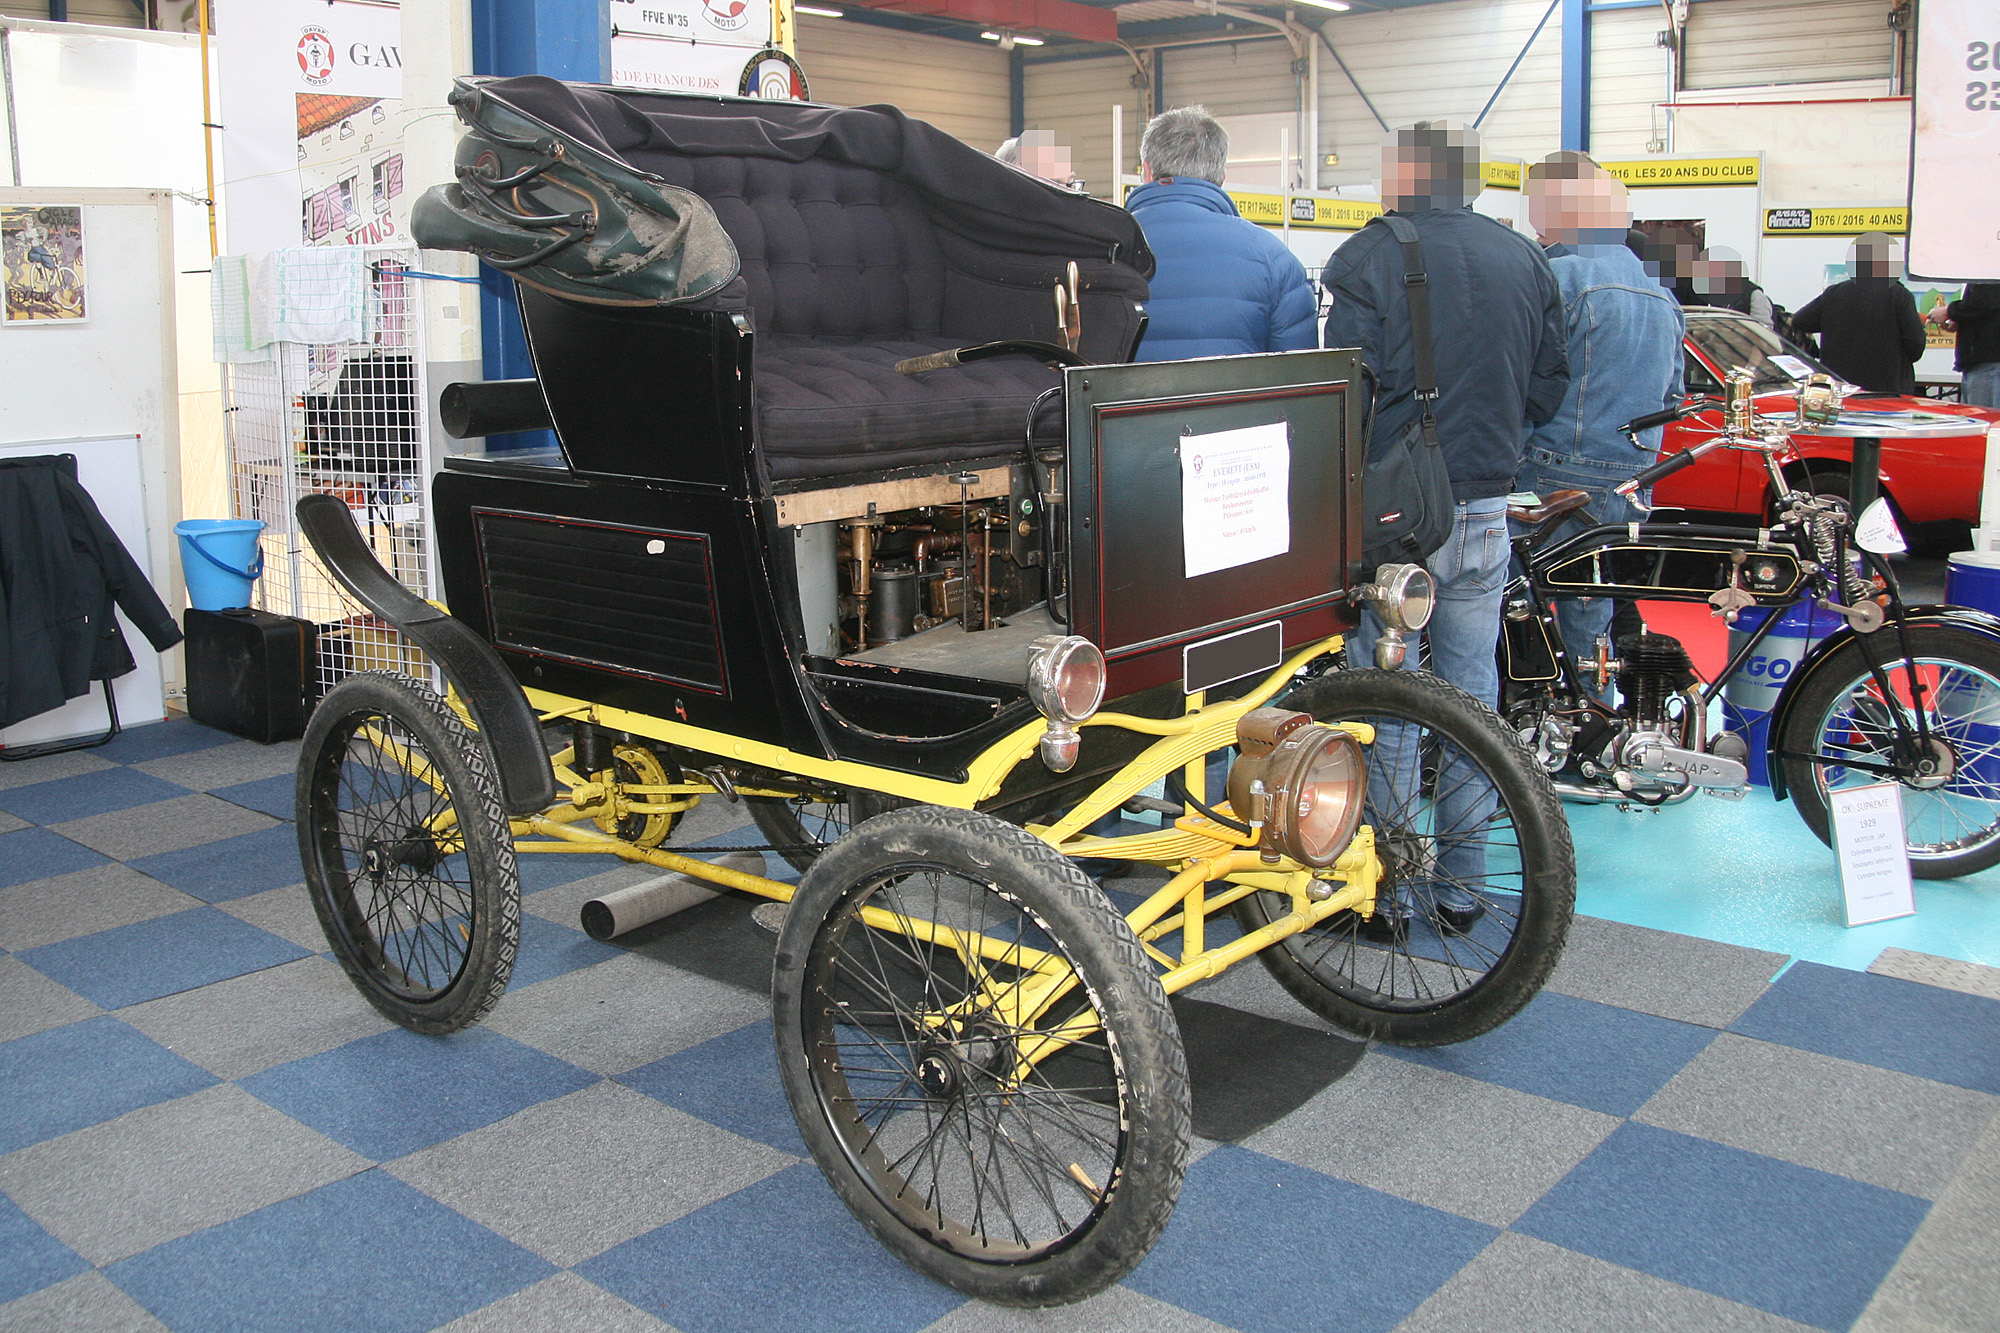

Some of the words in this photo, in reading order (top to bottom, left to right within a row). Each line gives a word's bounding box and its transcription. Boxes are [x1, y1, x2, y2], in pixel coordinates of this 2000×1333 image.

[642, 9, 665, 25] FFVE
[714, 16, 737, 28] MOTO
[622, 71, 642, 83] DE
[644, 73, 697, 88] FRANCE
[697, 77, 720, 89] DES
[1606, 169, 1629, 179] 016
[1636, 168, 1657, 179] LES
[1660, 167, 1672, 178] 20
[1675, 167, 1699, 177] ANS
[1702, 166, 1718, 177] DU
[1722, 165, 1754, 176] CLUB
[1259, 202, 1278, 216] PHASE
[1353, 209, 1365, 221] LES
[1768, 214, 1810, 228] AMICALE
[1814, 214, 1835, 226] 1976
[1843, 214, 1864, 226] 2016
[1869, 214, 1880, 225] 40
[1882, 213, 1903, 225] ANS
[345, 210, 395, 246] VINS
[1738, 655, 1792, 679] IGO
[1680, 761, 1710, 776] JAP
[1856, 798, 1889, 812] SUPREME
[1859, 818, 1877, 829] 1929
